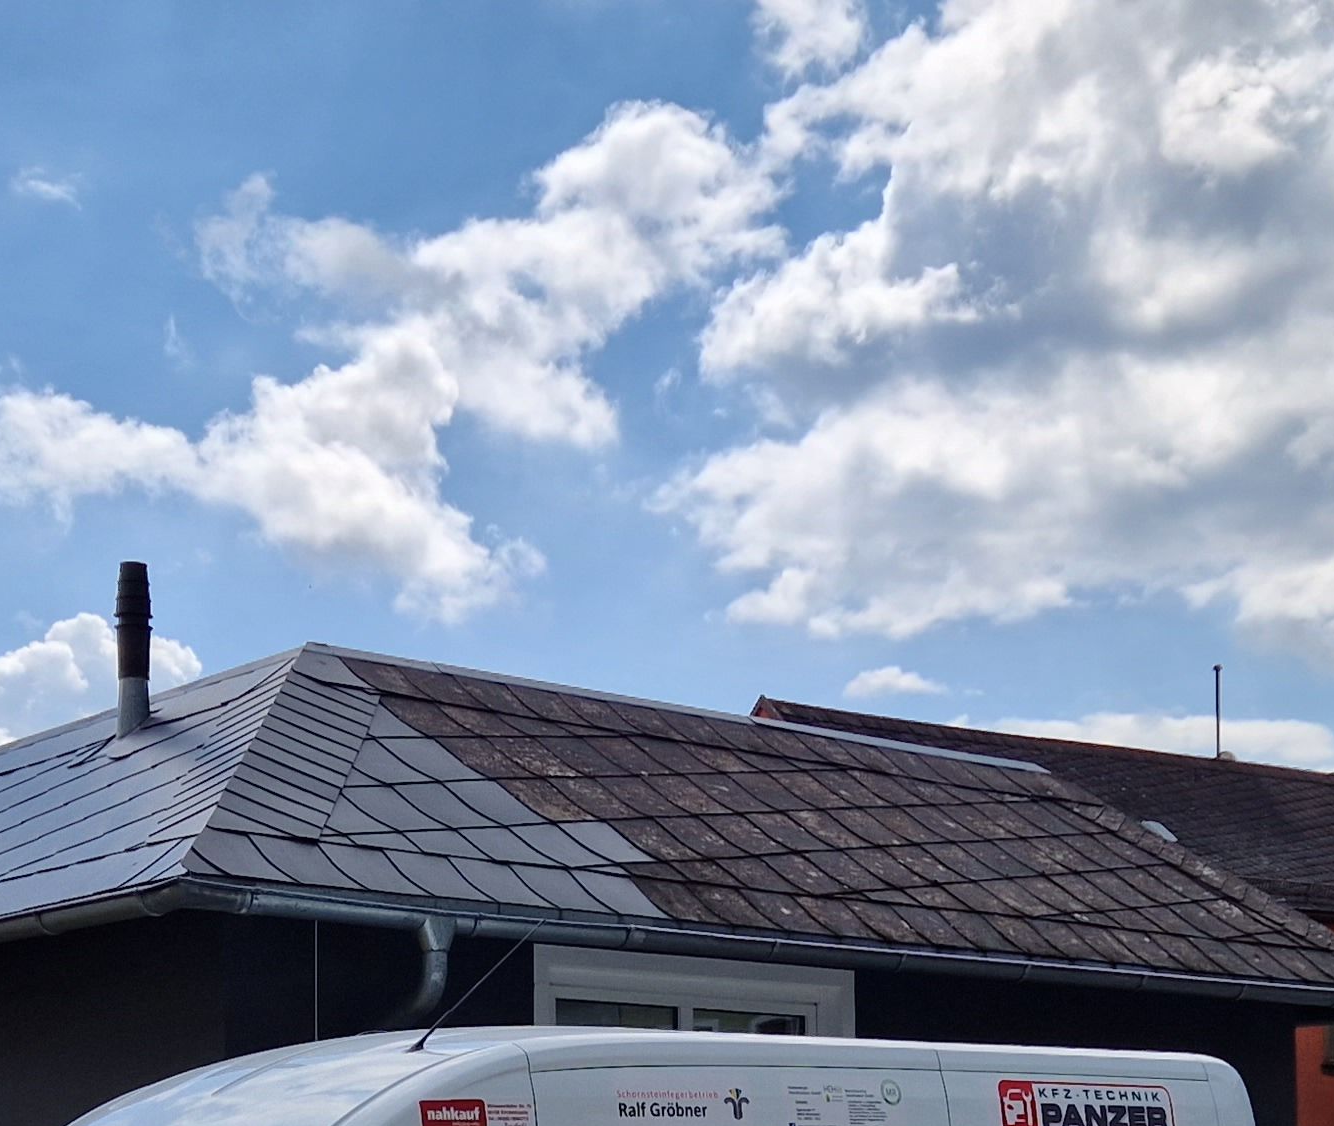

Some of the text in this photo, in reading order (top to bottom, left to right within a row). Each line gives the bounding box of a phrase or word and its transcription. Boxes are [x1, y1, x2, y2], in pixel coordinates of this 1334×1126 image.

[1038, 1087, 1161, 1102] KFZ-TECHNIK
[426, 1106, 481, 1121] nahkauf
[618, 1101, 708, 1118] Ralf Gröbner
